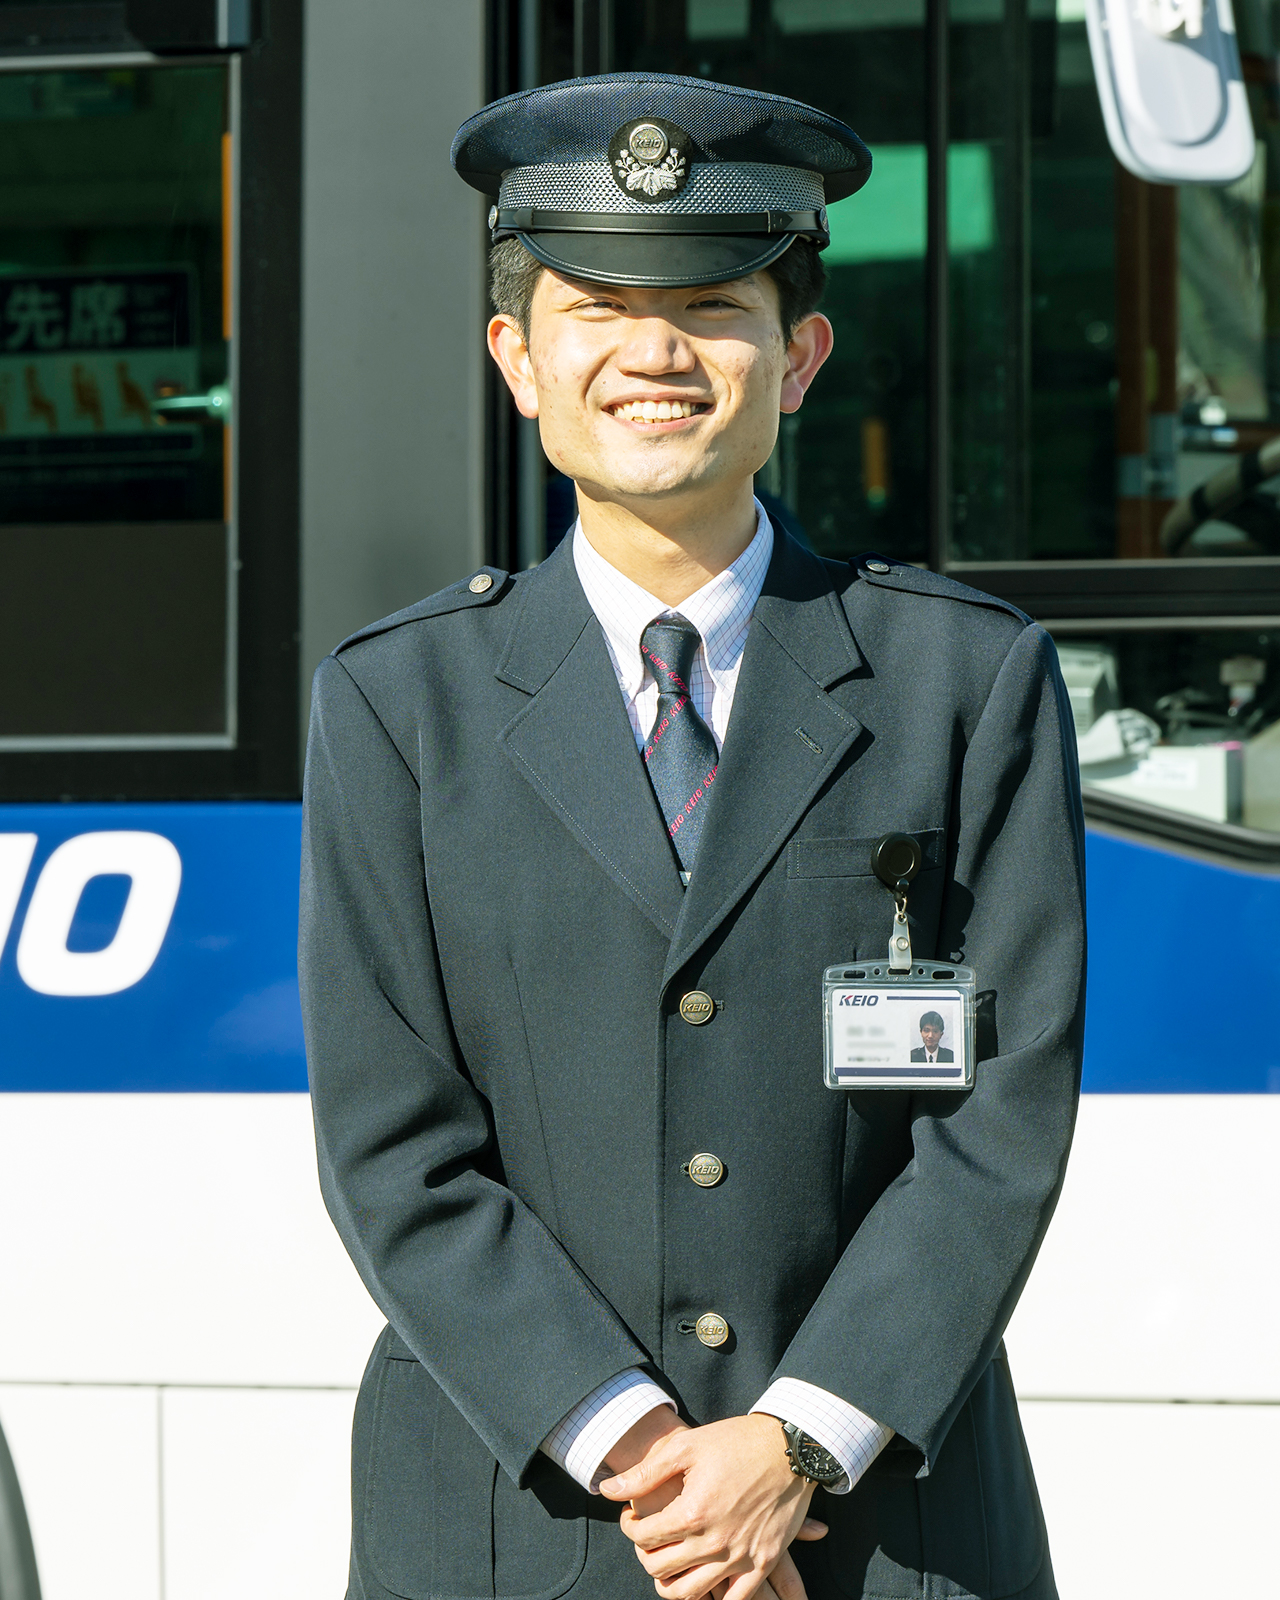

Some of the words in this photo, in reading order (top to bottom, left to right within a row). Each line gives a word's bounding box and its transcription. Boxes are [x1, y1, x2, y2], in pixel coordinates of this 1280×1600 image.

[635, 138, 662, 149] KEIO
[649, 653, 669, 670] KEIO
[667, 671, 689, 692] KEIO
[653, 718, 670, 744] KEIO
[669, 694, 688, 718] KEIO
[684, 788, 703, 814] KEIO
[838, 994, 879, 1007] KEIO
[682, 1003, 711, 1013] KEIO
[691, 1165, 720, 1175] KEIO
[698, 1325, 725, 1335] KEIO
